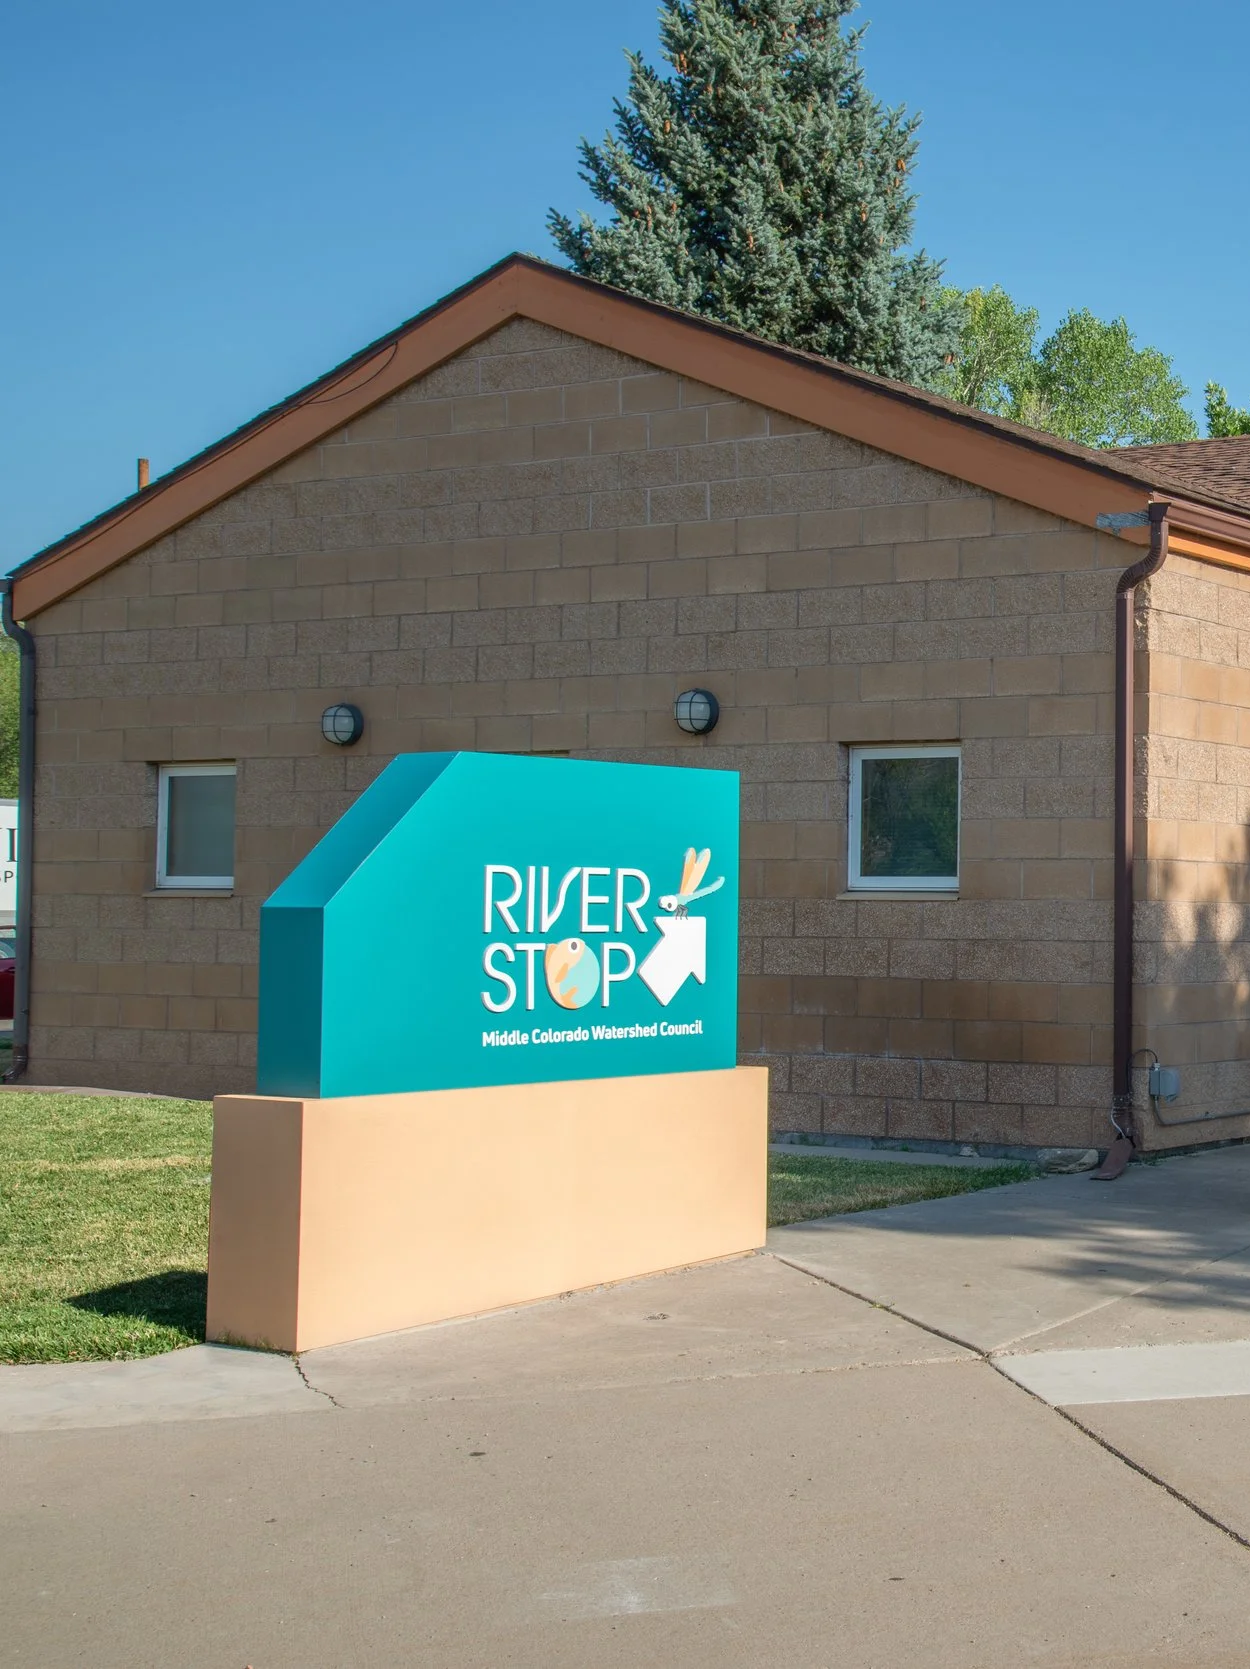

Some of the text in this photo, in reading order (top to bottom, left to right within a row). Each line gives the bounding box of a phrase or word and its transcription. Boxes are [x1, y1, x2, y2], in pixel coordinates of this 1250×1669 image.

[482, 864, 651, 933] RIVER
[480, 937, 636, 1013] STOP
[482, 1020, 703, 1047] Middle Colorado Watershed Council
